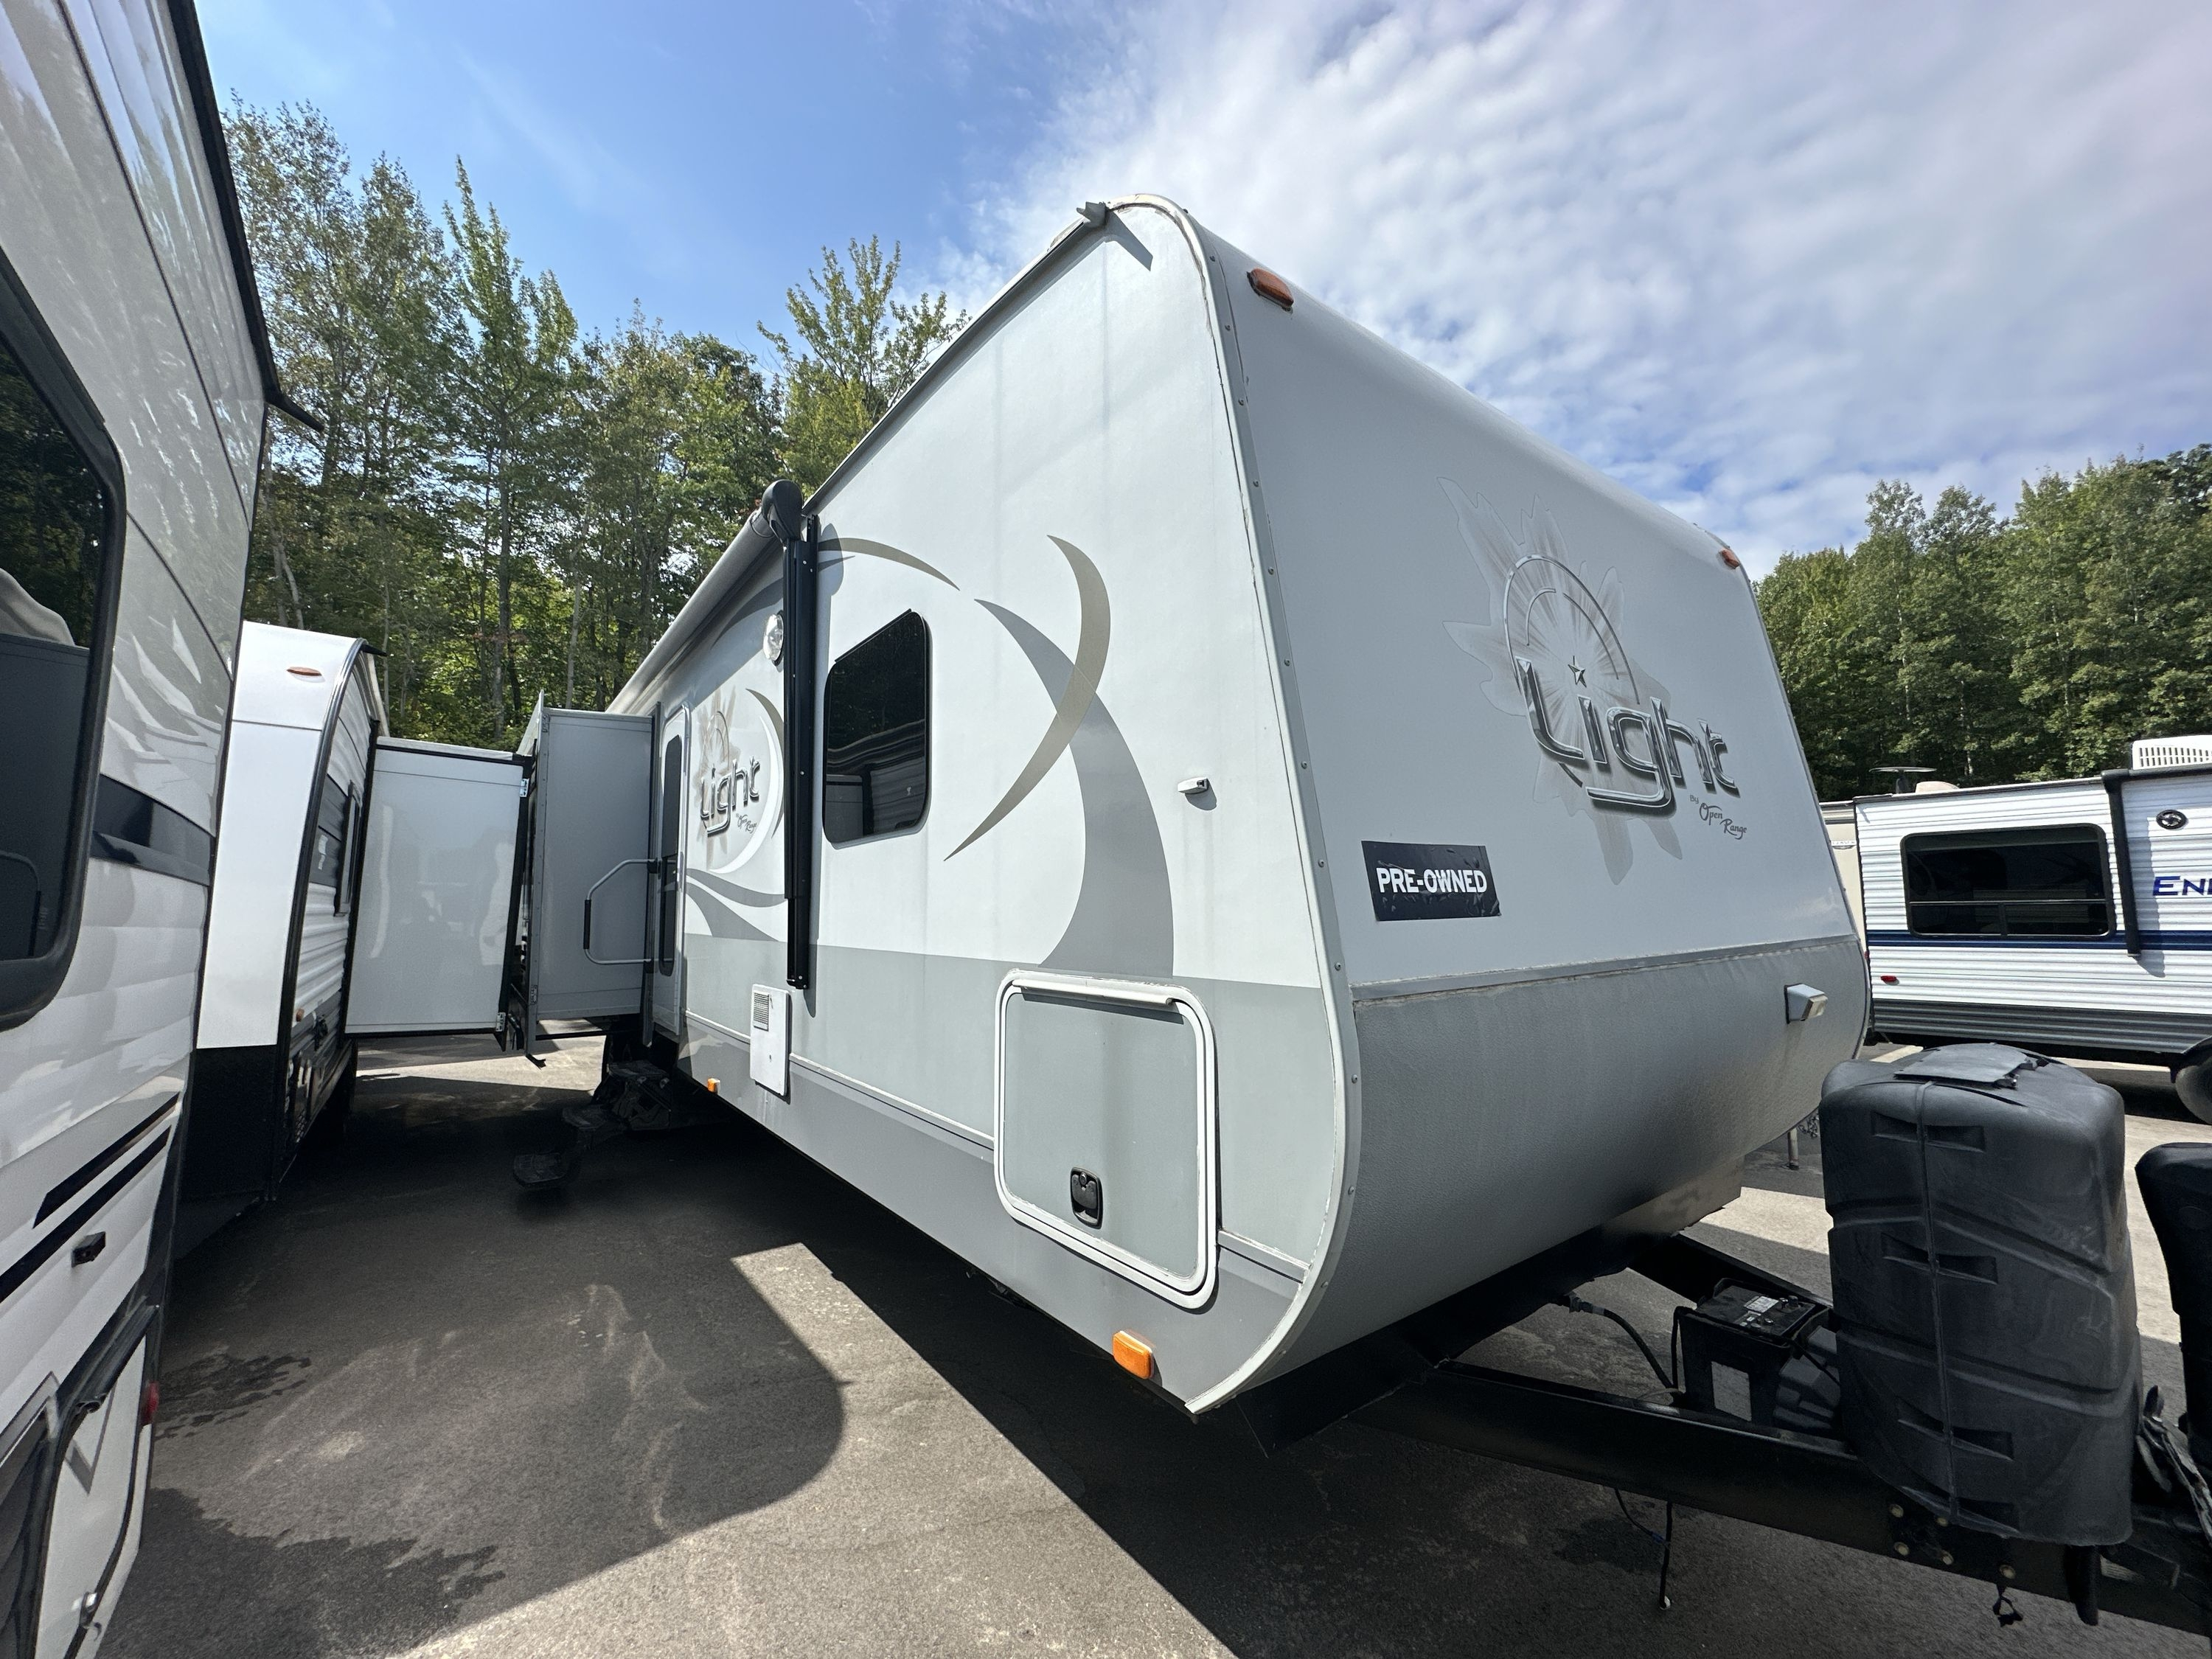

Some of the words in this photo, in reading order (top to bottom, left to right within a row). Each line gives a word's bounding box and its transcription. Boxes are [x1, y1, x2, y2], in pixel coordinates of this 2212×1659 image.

[1515, 655, 1739, 811] Light
[700, 757, 760, 837] Light
[1689, 795, 1699, 804] By
[1700, 802, 1723, 826] Open
[1719, 818, 1747, 840] Range
[1376, 867, 1487, 894] PRE-OWNED
[2152, 875, 2212, 896] EN
